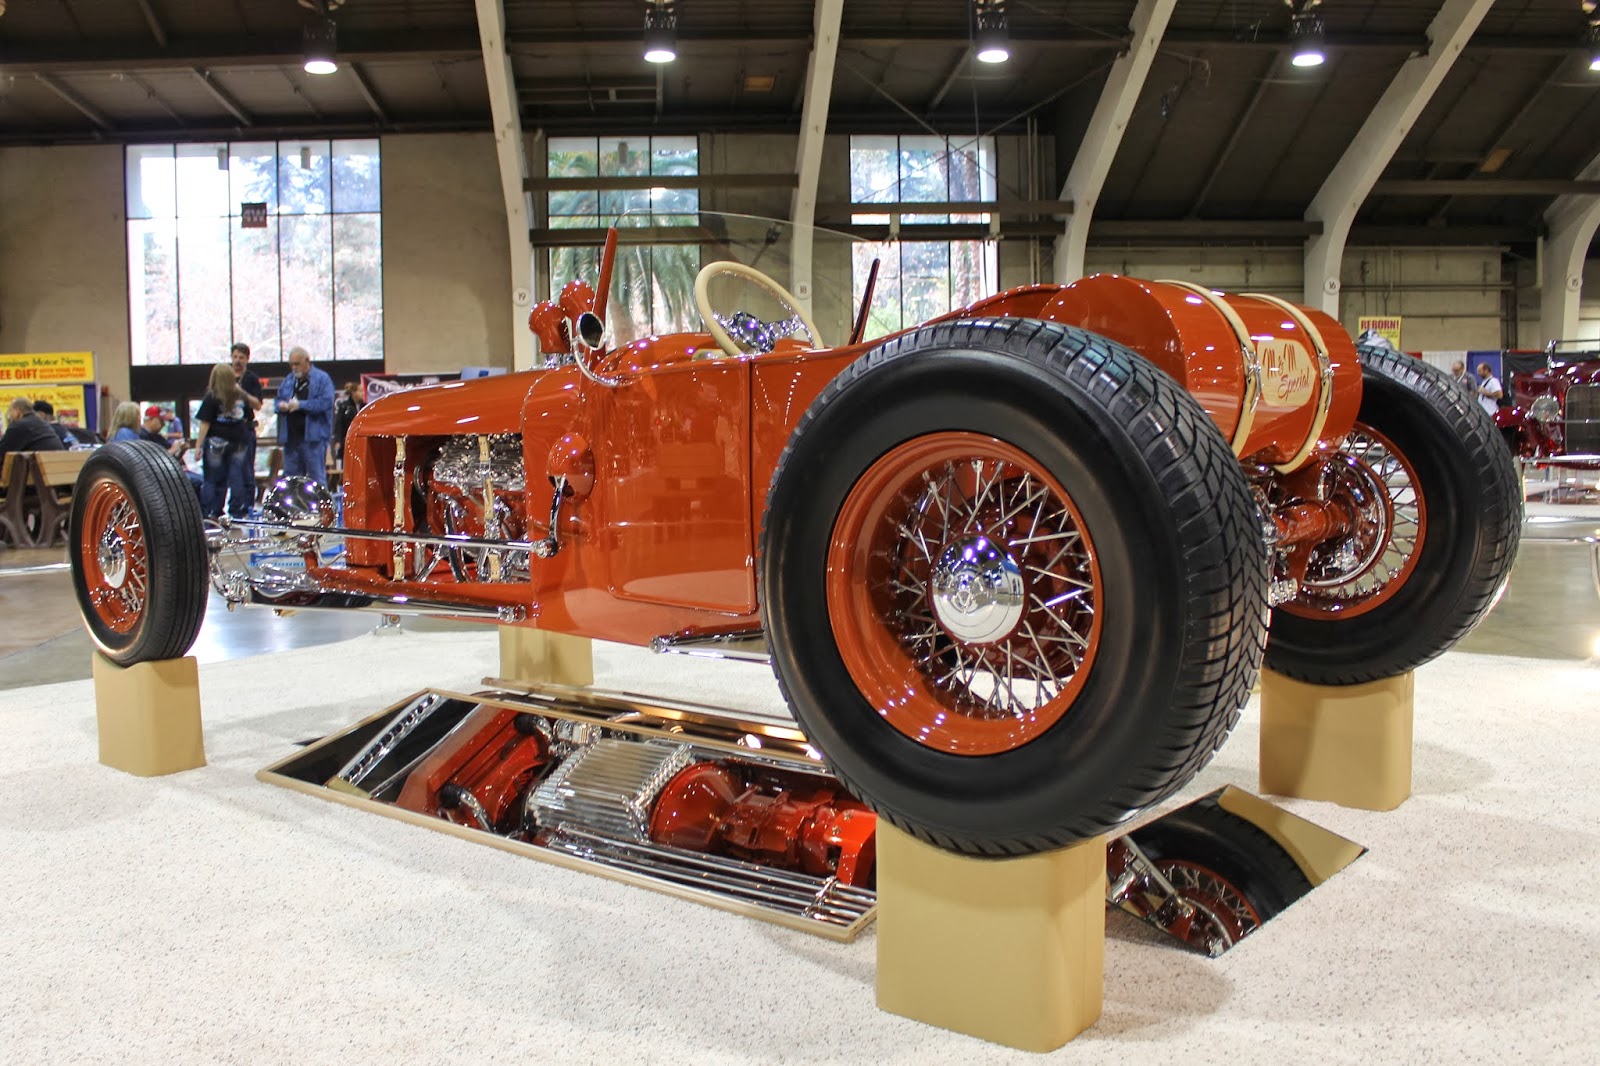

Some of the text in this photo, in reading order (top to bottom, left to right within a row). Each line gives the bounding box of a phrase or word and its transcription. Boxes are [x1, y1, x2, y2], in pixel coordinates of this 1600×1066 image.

[800, 285, 808, 295] 18
[518, 292, 527, 301] 19
[1361, 319, 1399, 330] REBORN!
[32, 357, 59, 365] Motor
[61, 356, 84, 364] News
[15, 368, 37, 379] GIFT
